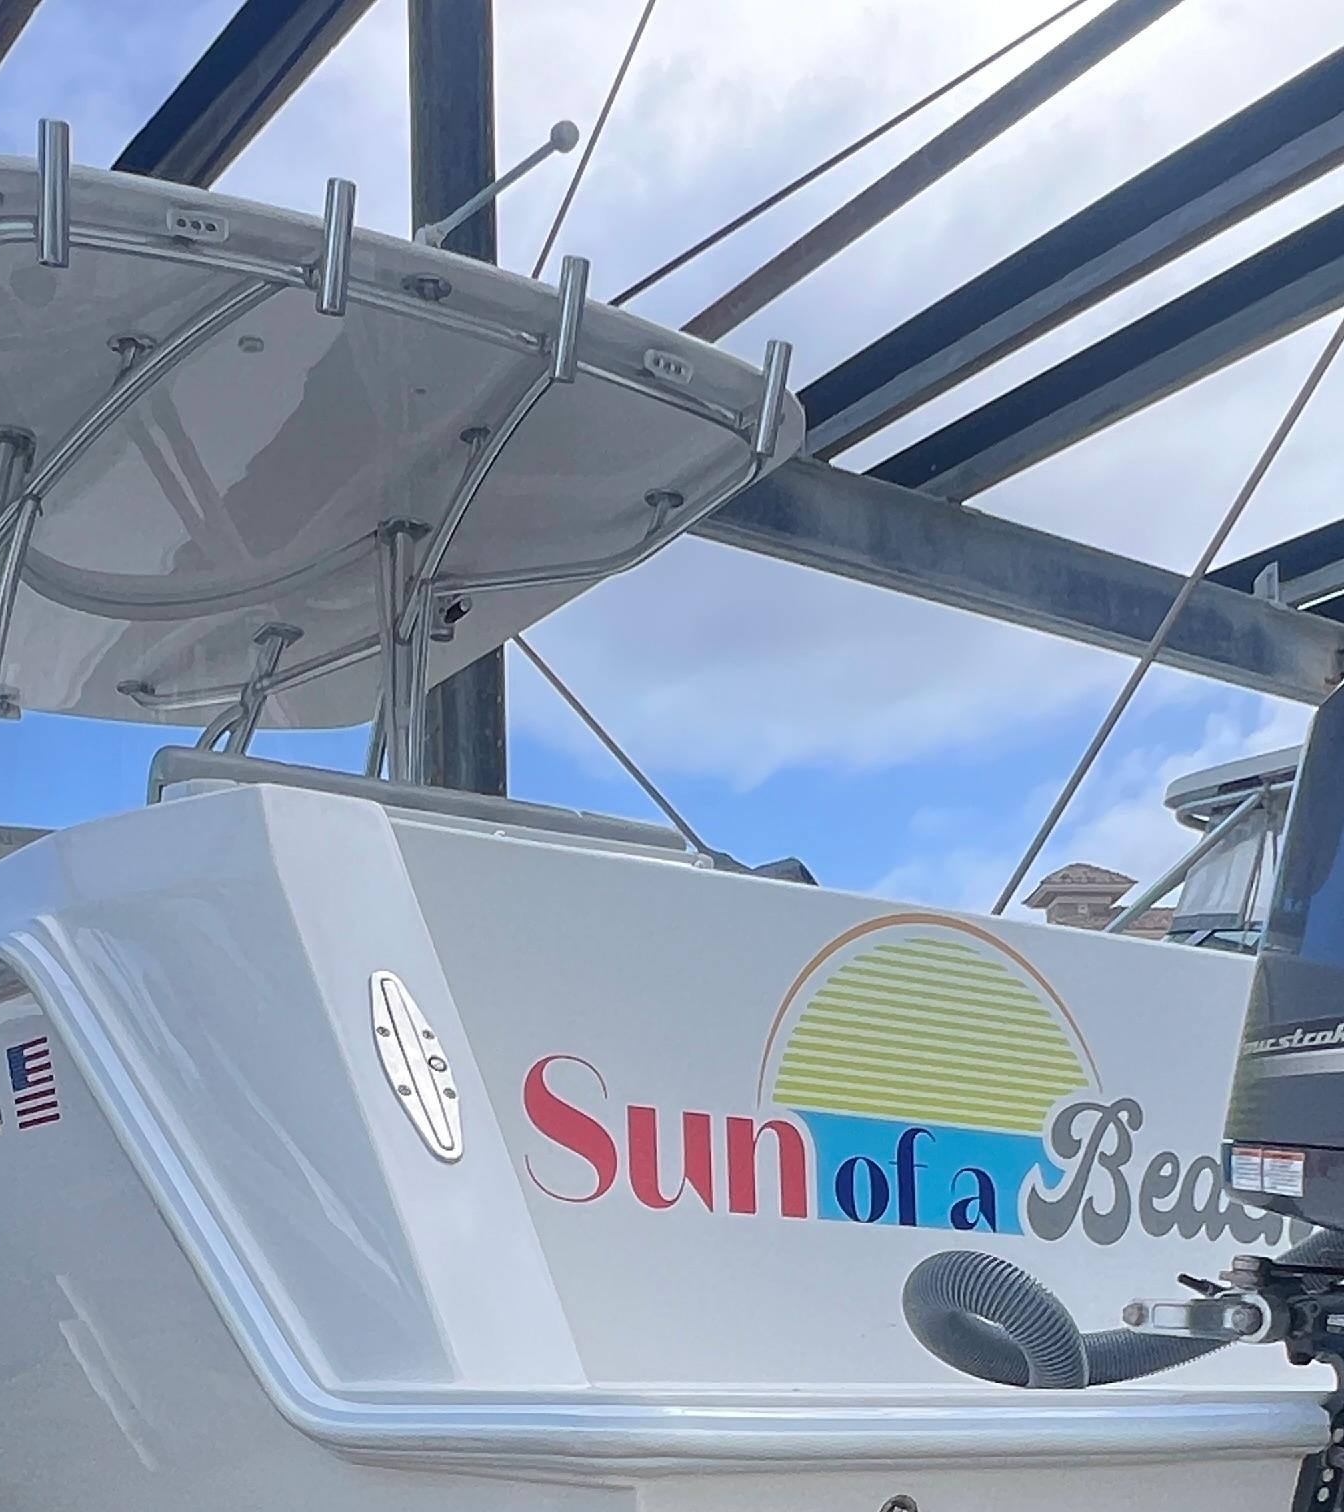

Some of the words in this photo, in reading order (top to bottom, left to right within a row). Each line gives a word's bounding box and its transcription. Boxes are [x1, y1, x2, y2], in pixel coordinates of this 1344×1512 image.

[523, 1055, 808, 1219] Sun
[835, 1127, 936, 1227] of
[950, 1167, 997, 1233] a
[1026, 1097, 1313, 1246] Bea
